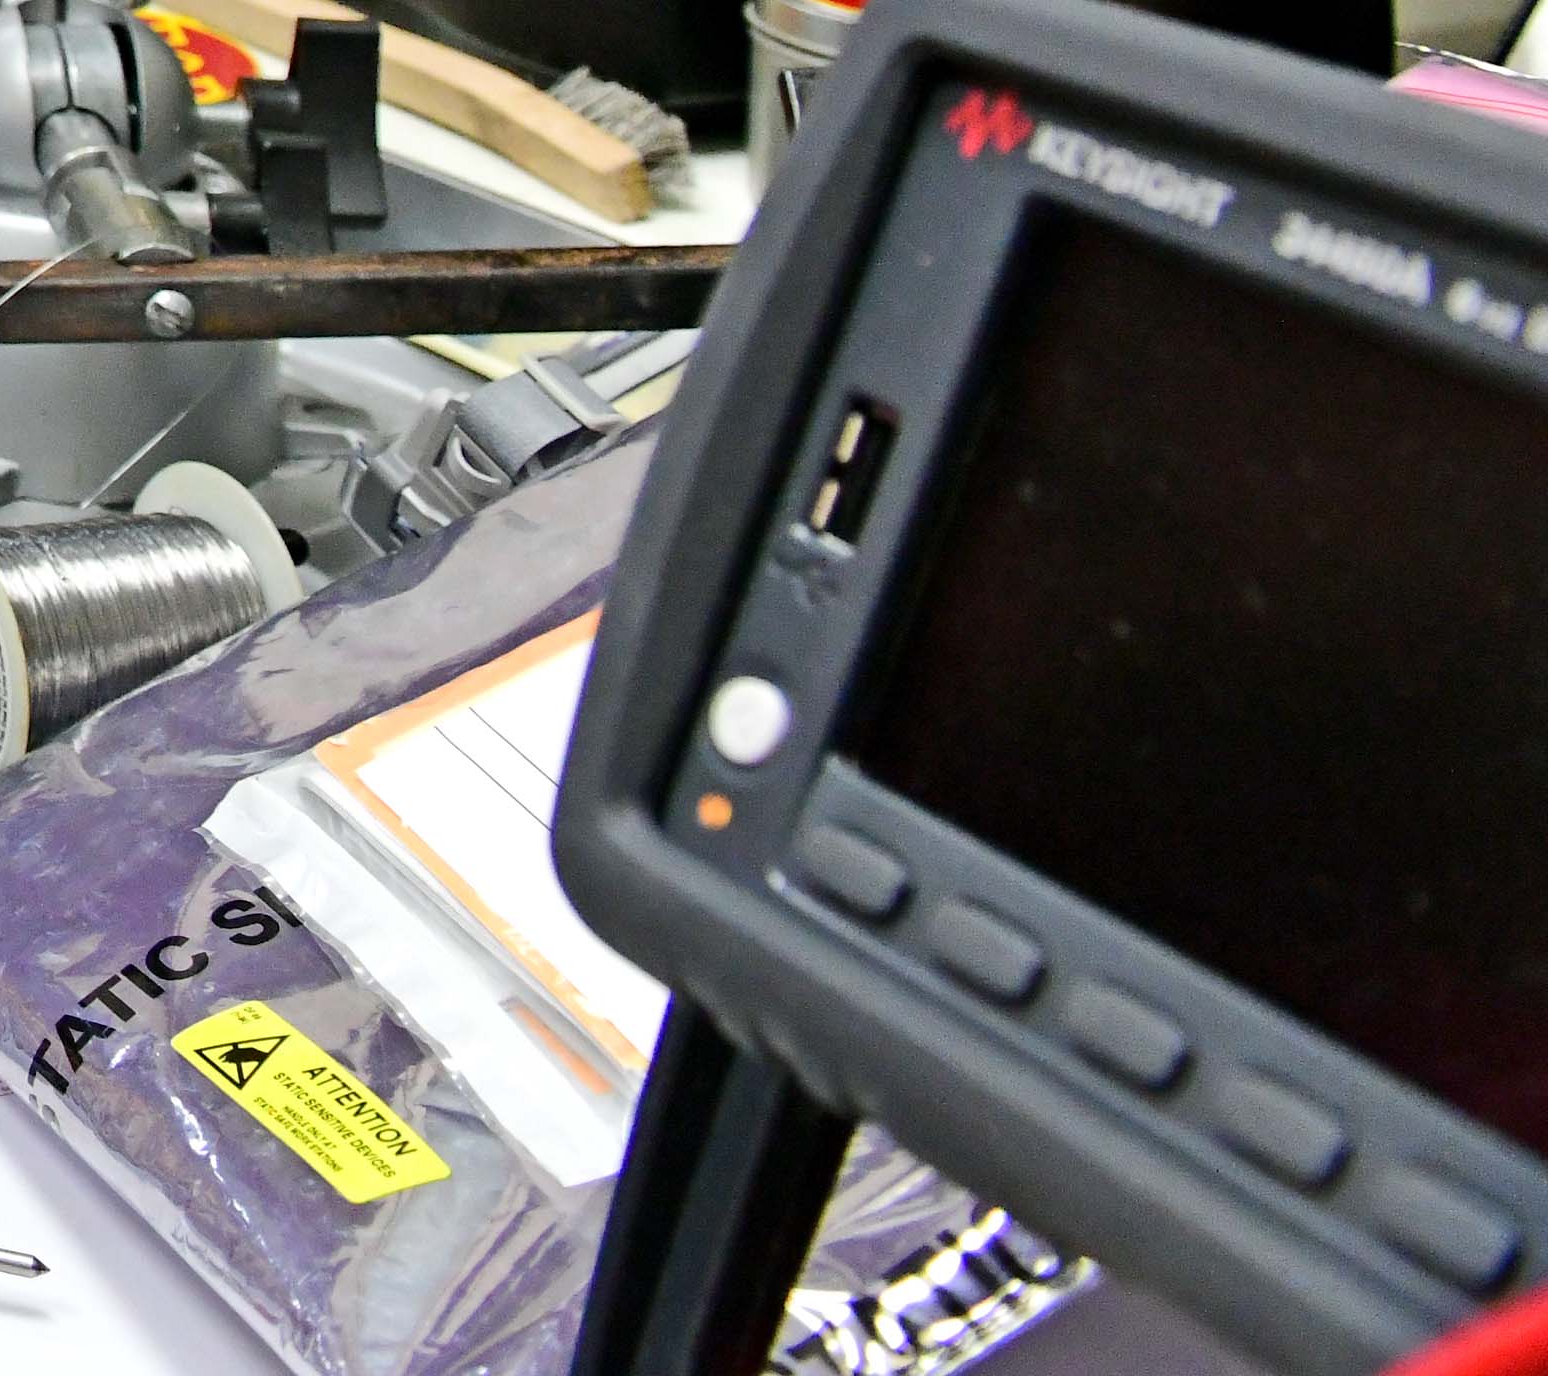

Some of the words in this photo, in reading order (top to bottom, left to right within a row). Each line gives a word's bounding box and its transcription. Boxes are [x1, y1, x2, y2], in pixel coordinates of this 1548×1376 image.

[27, 935, 209, 1108] TATIC
[273, 1072, 309, 1100] STATIC
[304, 1098, 355, 1140] SENSITIVE
[348, 1138, 396, 1179] DEVICES
[302, 1066, 418, 1157] ATTENTION
